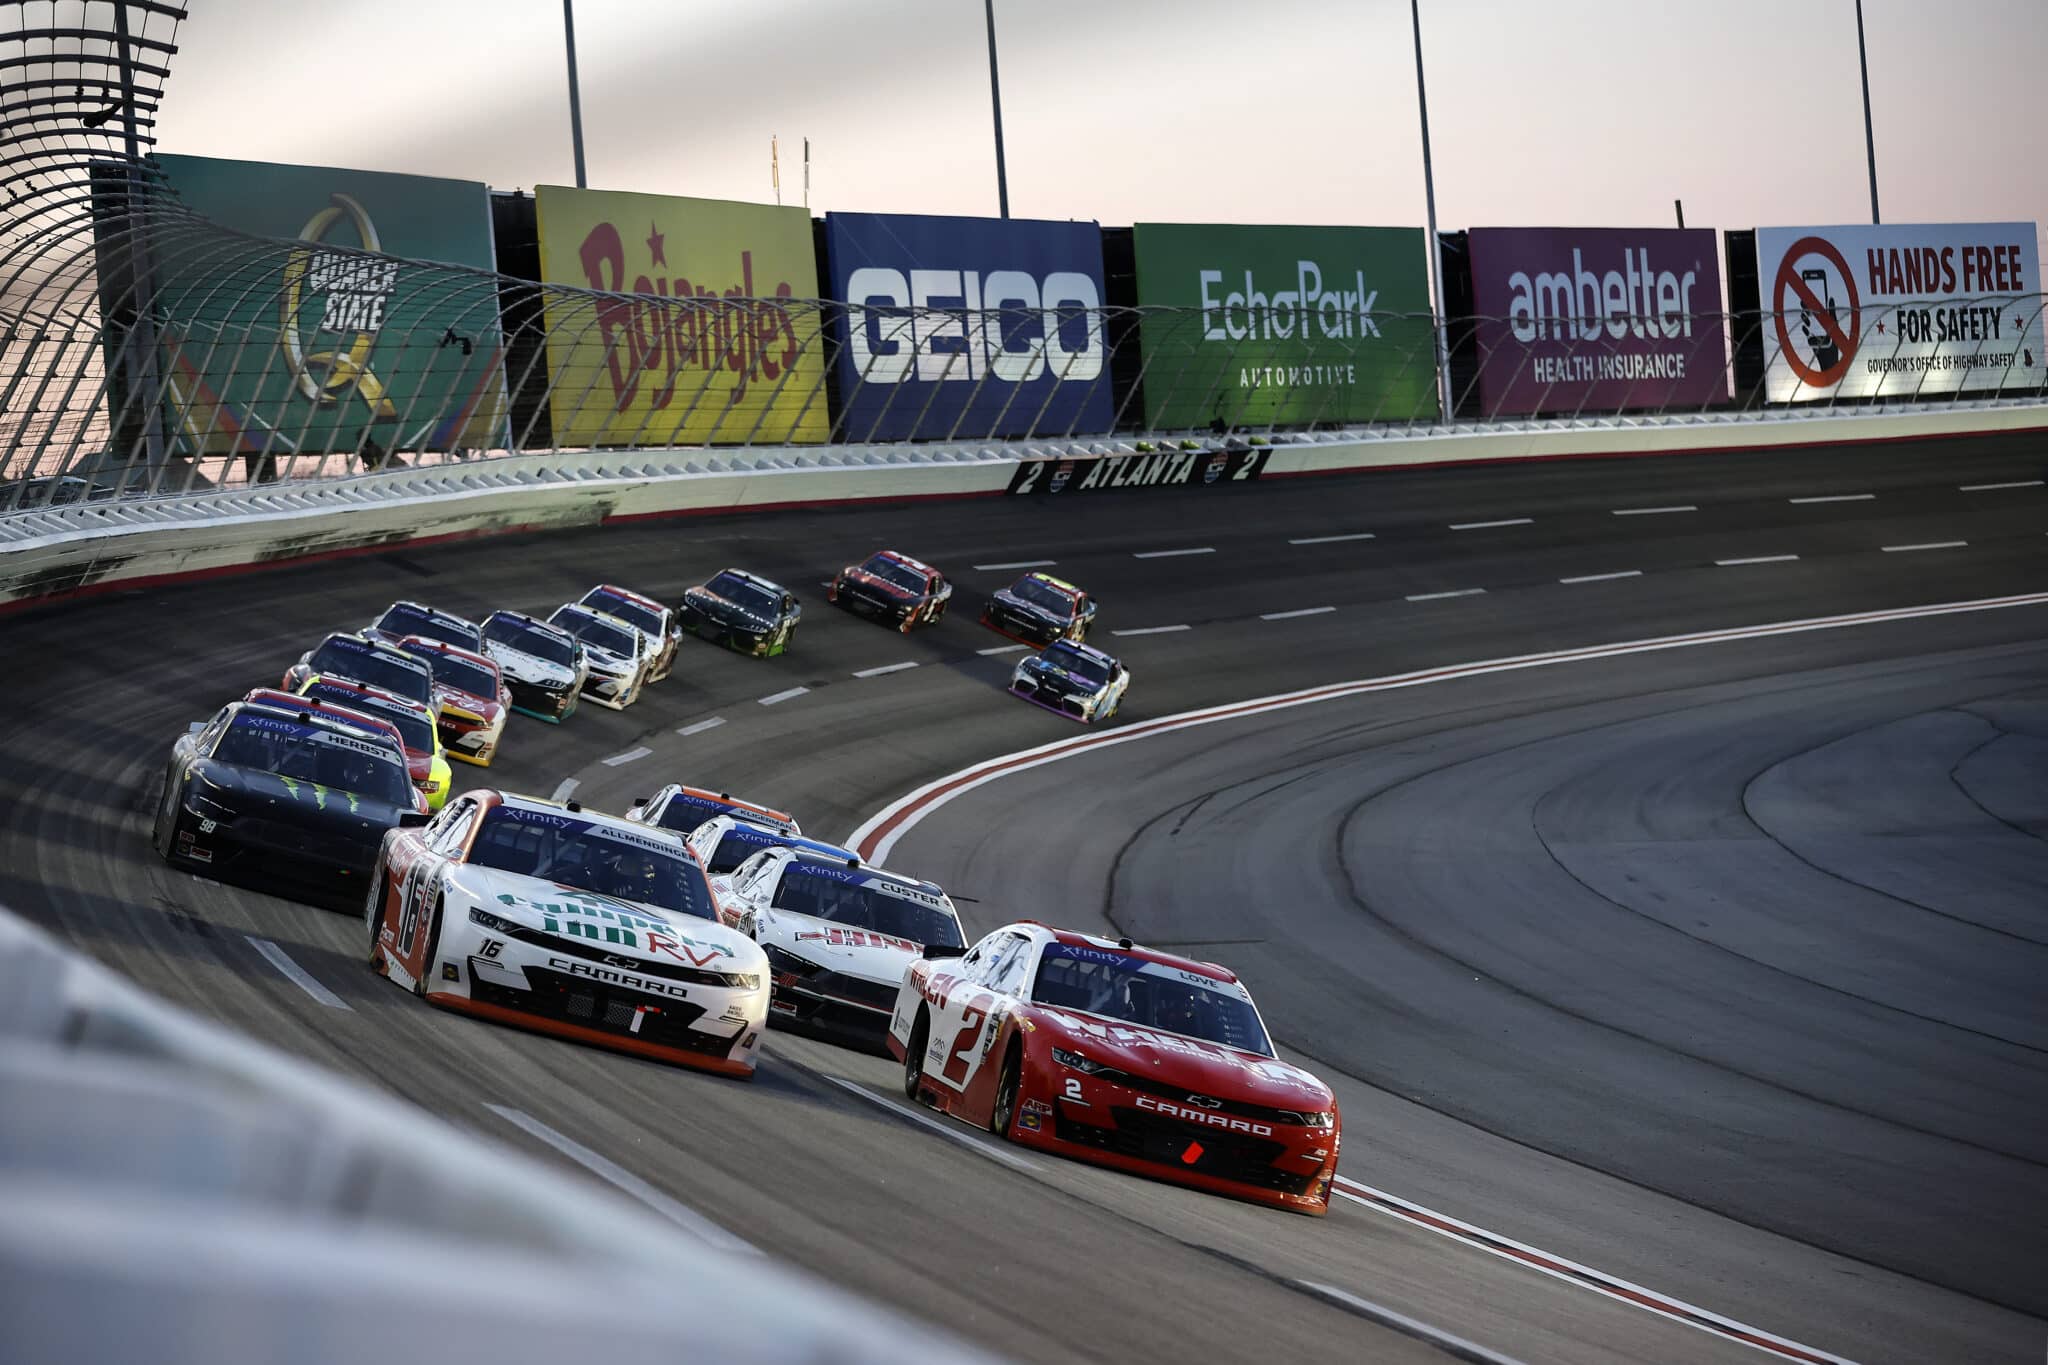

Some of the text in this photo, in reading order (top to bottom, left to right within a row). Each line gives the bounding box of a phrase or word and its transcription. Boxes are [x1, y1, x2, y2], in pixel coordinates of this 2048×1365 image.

[1867, 245, 2024, 295] HANDS FREE
[322, 292, 386, 330] STATE
[1199, 260, 1381, 341] EchoPark
[1508, 247, 1696, 343] ambetter
[579, 222, 797, 413] Bojangles
[847, 267, 1104, 384] GEICO
[1897, 306, 2001, 344] FOR SAFETY
[1240, 364, 1355, 388] AUTOMOTIVE
[1534, 353, 1686, 383] HEALTH INSURANCE
[1867, 352, 2016, 374] GOVERNOR'S OFFICE OF HIGHWAY SAFETY
[1016, 448, 1259, 494] 2 ATLANTA 2
[385, 702, 417, 716] JONES
[248, 717, 390, 759] xfinity HERBST
[504, 807, 696, 862] xfinity ALLMENDINGER
[800, 864, 940, 907] xfinity CUSTER
[479, 937, 505, 958] 16
[647, 932, 722, 967] RV
[1062, 945, 1219, 989] xfinity LOVE
[549, 957, 689, 998] CAMARO
[942, 993, 995, 1086] 2
[1065, 1078, 1083, 1100] 2
[1135, 1096, 1273, 1137] CAMARO
